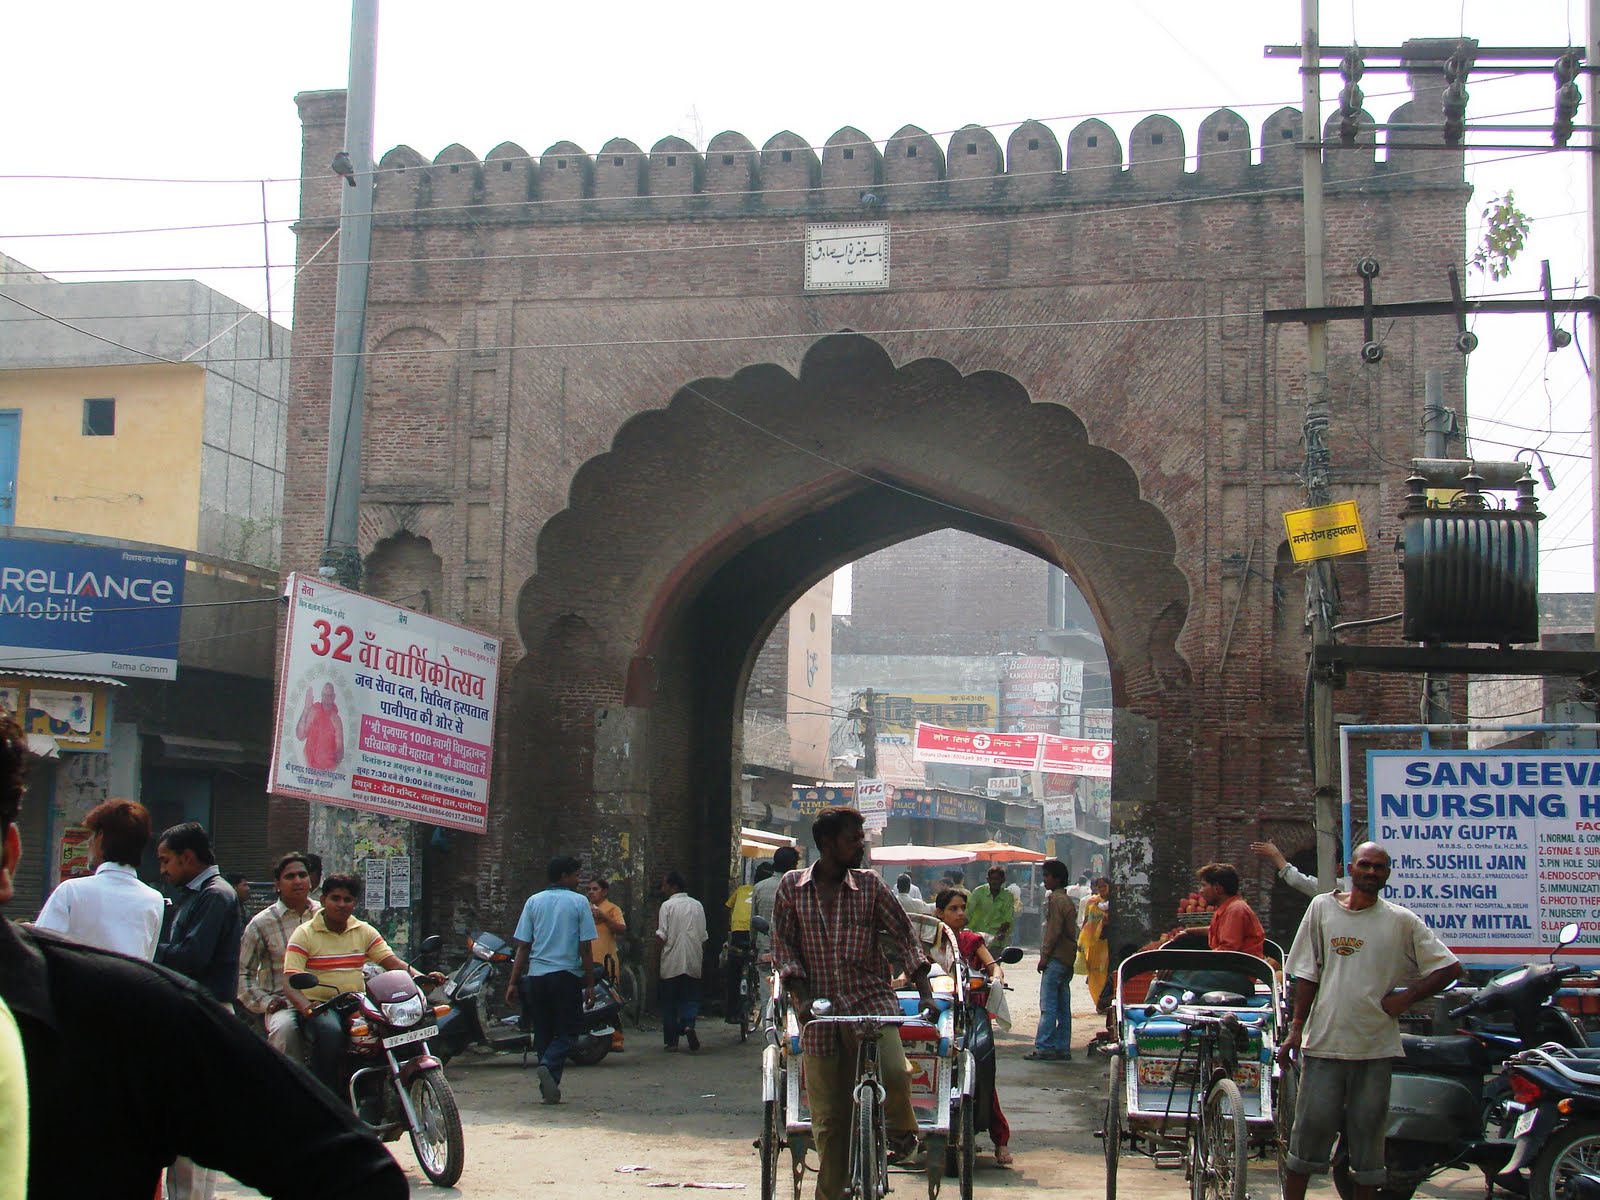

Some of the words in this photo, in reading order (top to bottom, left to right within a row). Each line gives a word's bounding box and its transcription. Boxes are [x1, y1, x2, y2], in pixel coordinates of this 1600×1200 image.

[1292, 530, 1325, 544] मनोरोग
[0, 594, 94, 623] Mobile
[310, 618, 354, 663] 32
[386, 645, 486, 700] वार्षिकोत्सव
[112, 661, 136, 671] Rama
[140, 664, 168, 674] Comm
[355, 674, 373, 689] जन
[376, 675, 396, 695] सेवा
[420, 686, 452, 710] सिविल
[454, 700, 489, 721] हस्पताल
[380, 700, 418, 721] पानीपत
[420, 708, 433, 726] की
[435, 712, 453, 731] ओर
[455, 717, 464, 734] से
[410, 732, 432, 746] 1008
[978, 736, 985, 746] 5
[398, 742, 407, 756] जी
[371, 770, 387, 778] 7:30
[405, 777, 422, 785] 9:00
[456, 778, 473, 786] 2008
[990, 779, 1018, 788] RAJU
[1380, 794, 1566, 818] NURSING
[1382, 826, 1399, 840] Dr.
[1401, 825, 1453, 840] VIJAY
[1458, 825, 1518, 840] GUPTA
[1402, 855, 1425, 869] Mrs.
[1426, 855, 1483, 870] SUSHIL
[1486, 855, 1526, 870] JAIN
[1563, 859, 1583, 868] HOLE
[1587, 859, 1600, 868] SU
[1384, 885, 1401, 899] Dr.
[1549, 909, 1586, 918] NURSERY
[1472, 915, 1532, 929] MITTAL
[1331, 936, 1364, 949] VANS
